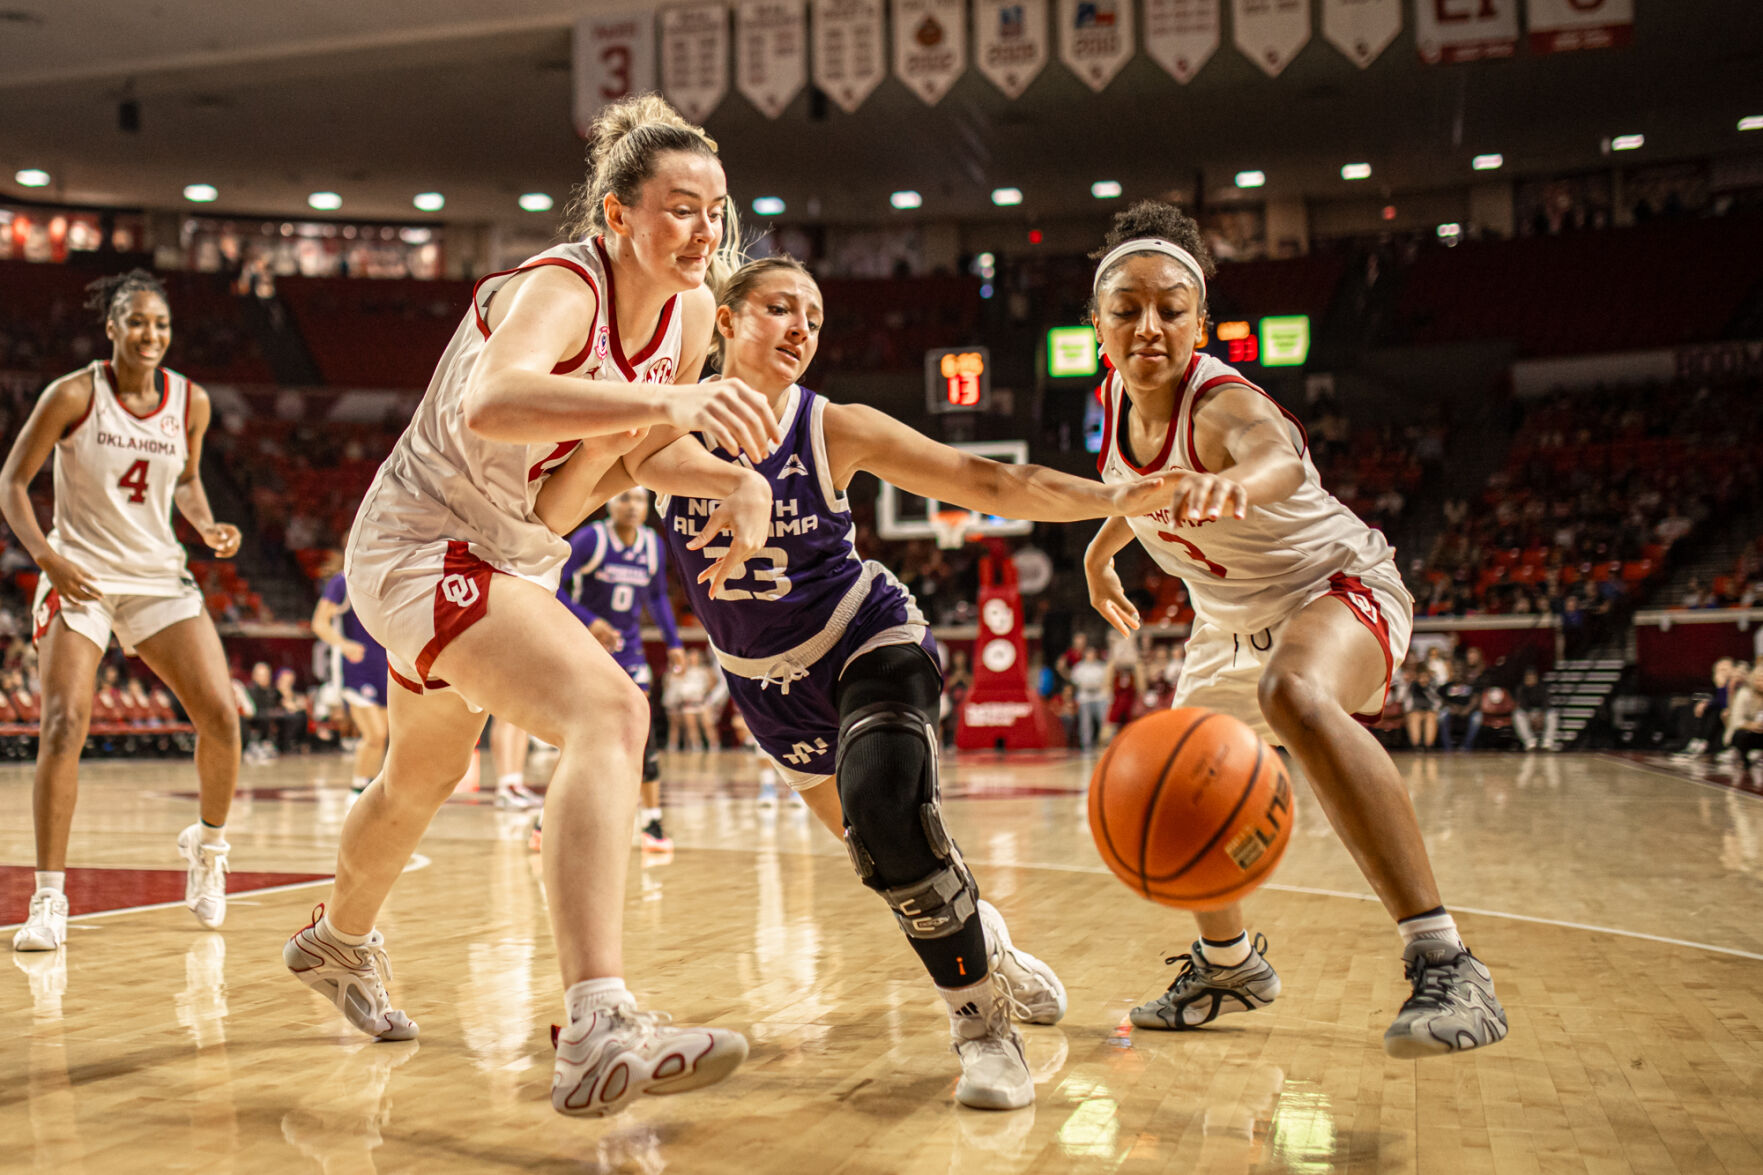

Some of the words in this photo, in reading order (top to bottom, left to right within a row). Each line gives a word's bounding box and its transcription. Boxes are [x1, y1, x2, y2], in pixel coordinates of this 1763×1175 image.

[601, 45, 632, 99] 3
[97, 431, 176, 455] OKLAHOMA
[117, 458, 150, 505] 4
[674, 514, 819, 538] ALMA
[441, 573, 480, 608] OU
[703, 546, 792, 601] 23
[611, 584, 634, 611] 0
